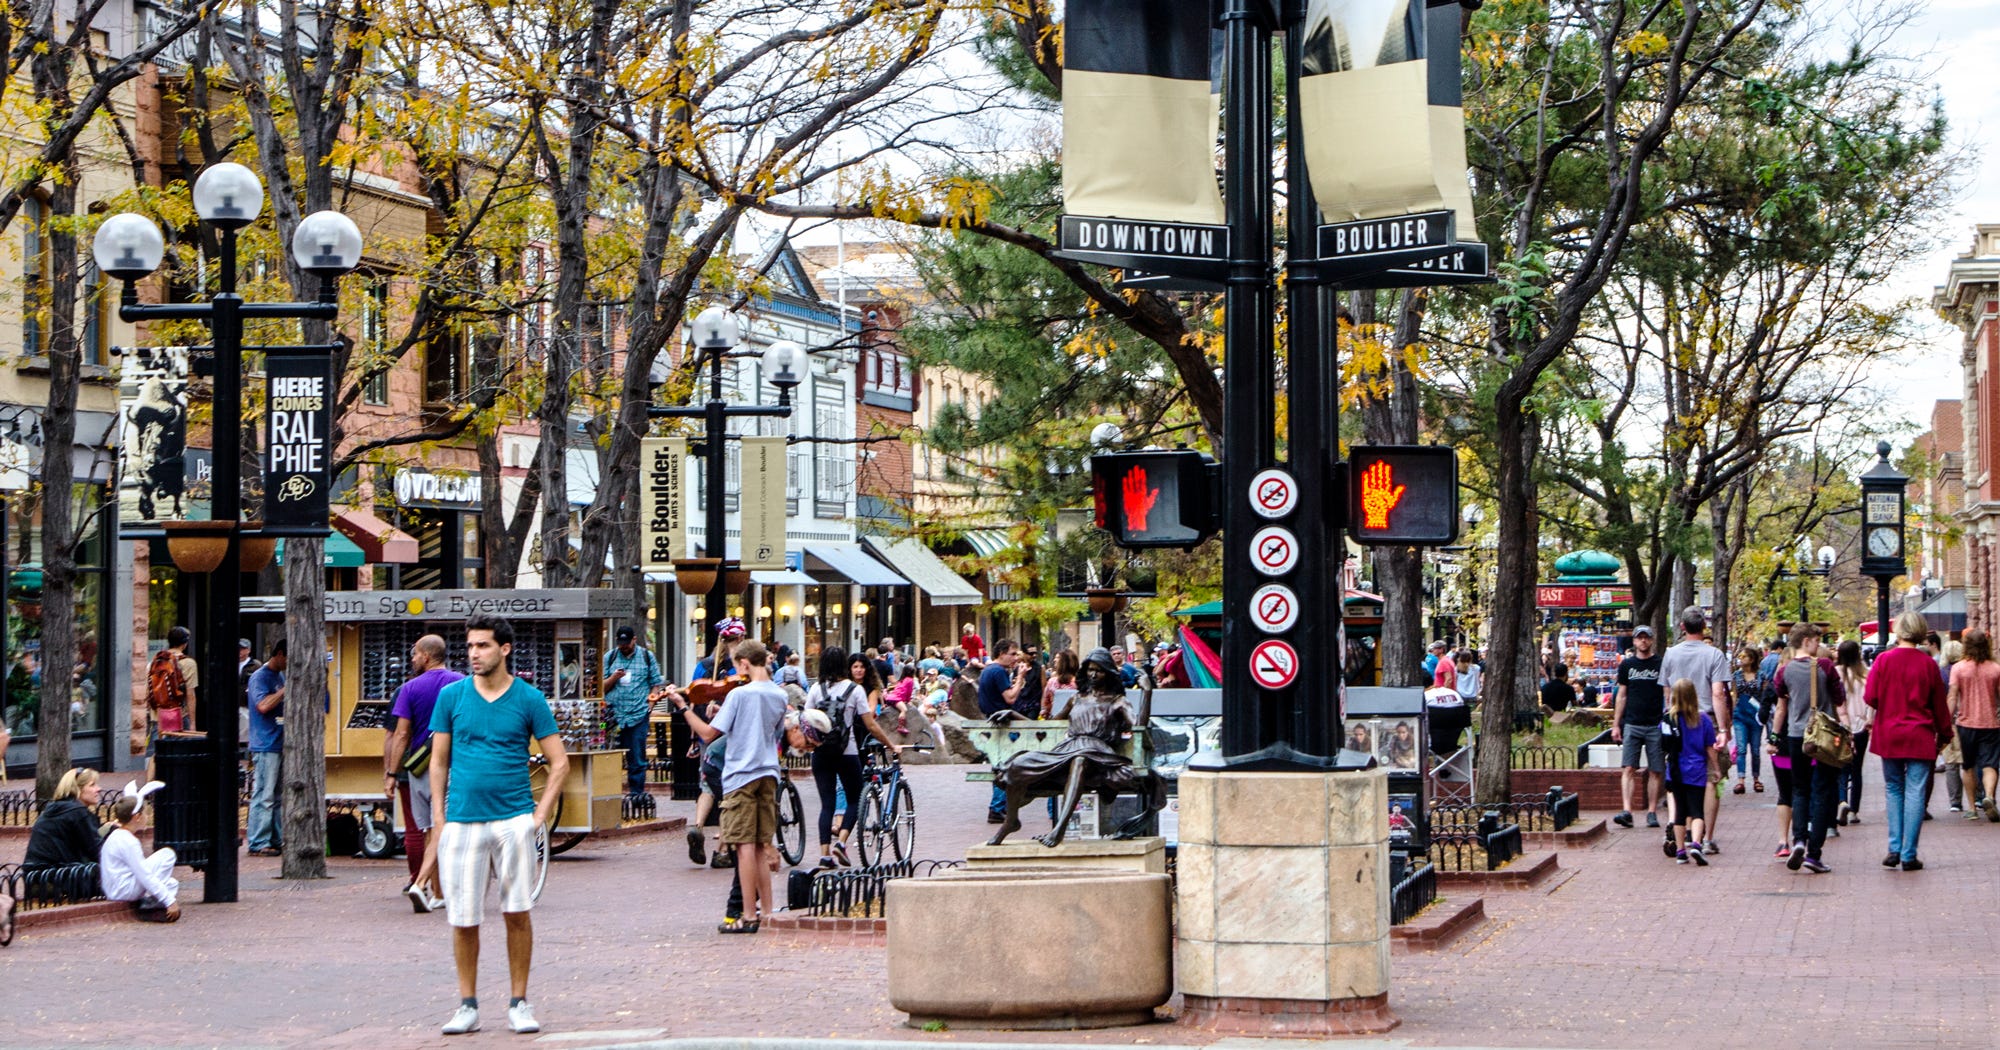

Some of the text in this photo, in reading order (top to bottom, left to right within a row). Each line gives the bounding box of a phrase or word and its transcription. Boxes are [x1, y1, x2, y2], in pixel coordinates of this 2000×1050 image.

[1079, 222, 1213, 255] DOWNTOWN
[1336, 218, 1428, 254] BOULDER
[272, 377, 324, 398] HERE
[272, 396, 323, 411] COMES
[271, 411, 323, 444] RAL
[271, 444, 323, 473] PHIE
[671, 453, 679, 490] SCIENCES
[411, 472, 482, 502] VOLCOM
[650, 446, 670, 563] Be Boulder.
[671, 500, 679, 520] ARTS
[1871, 503, 1896, 512] STATE
[1872, 512, 1894, 521] BANK
[379, 596, 436, 617] Spot
[449, 596, 554, 617] Eyewear
[1540, 588, 1564, 601] EAST
